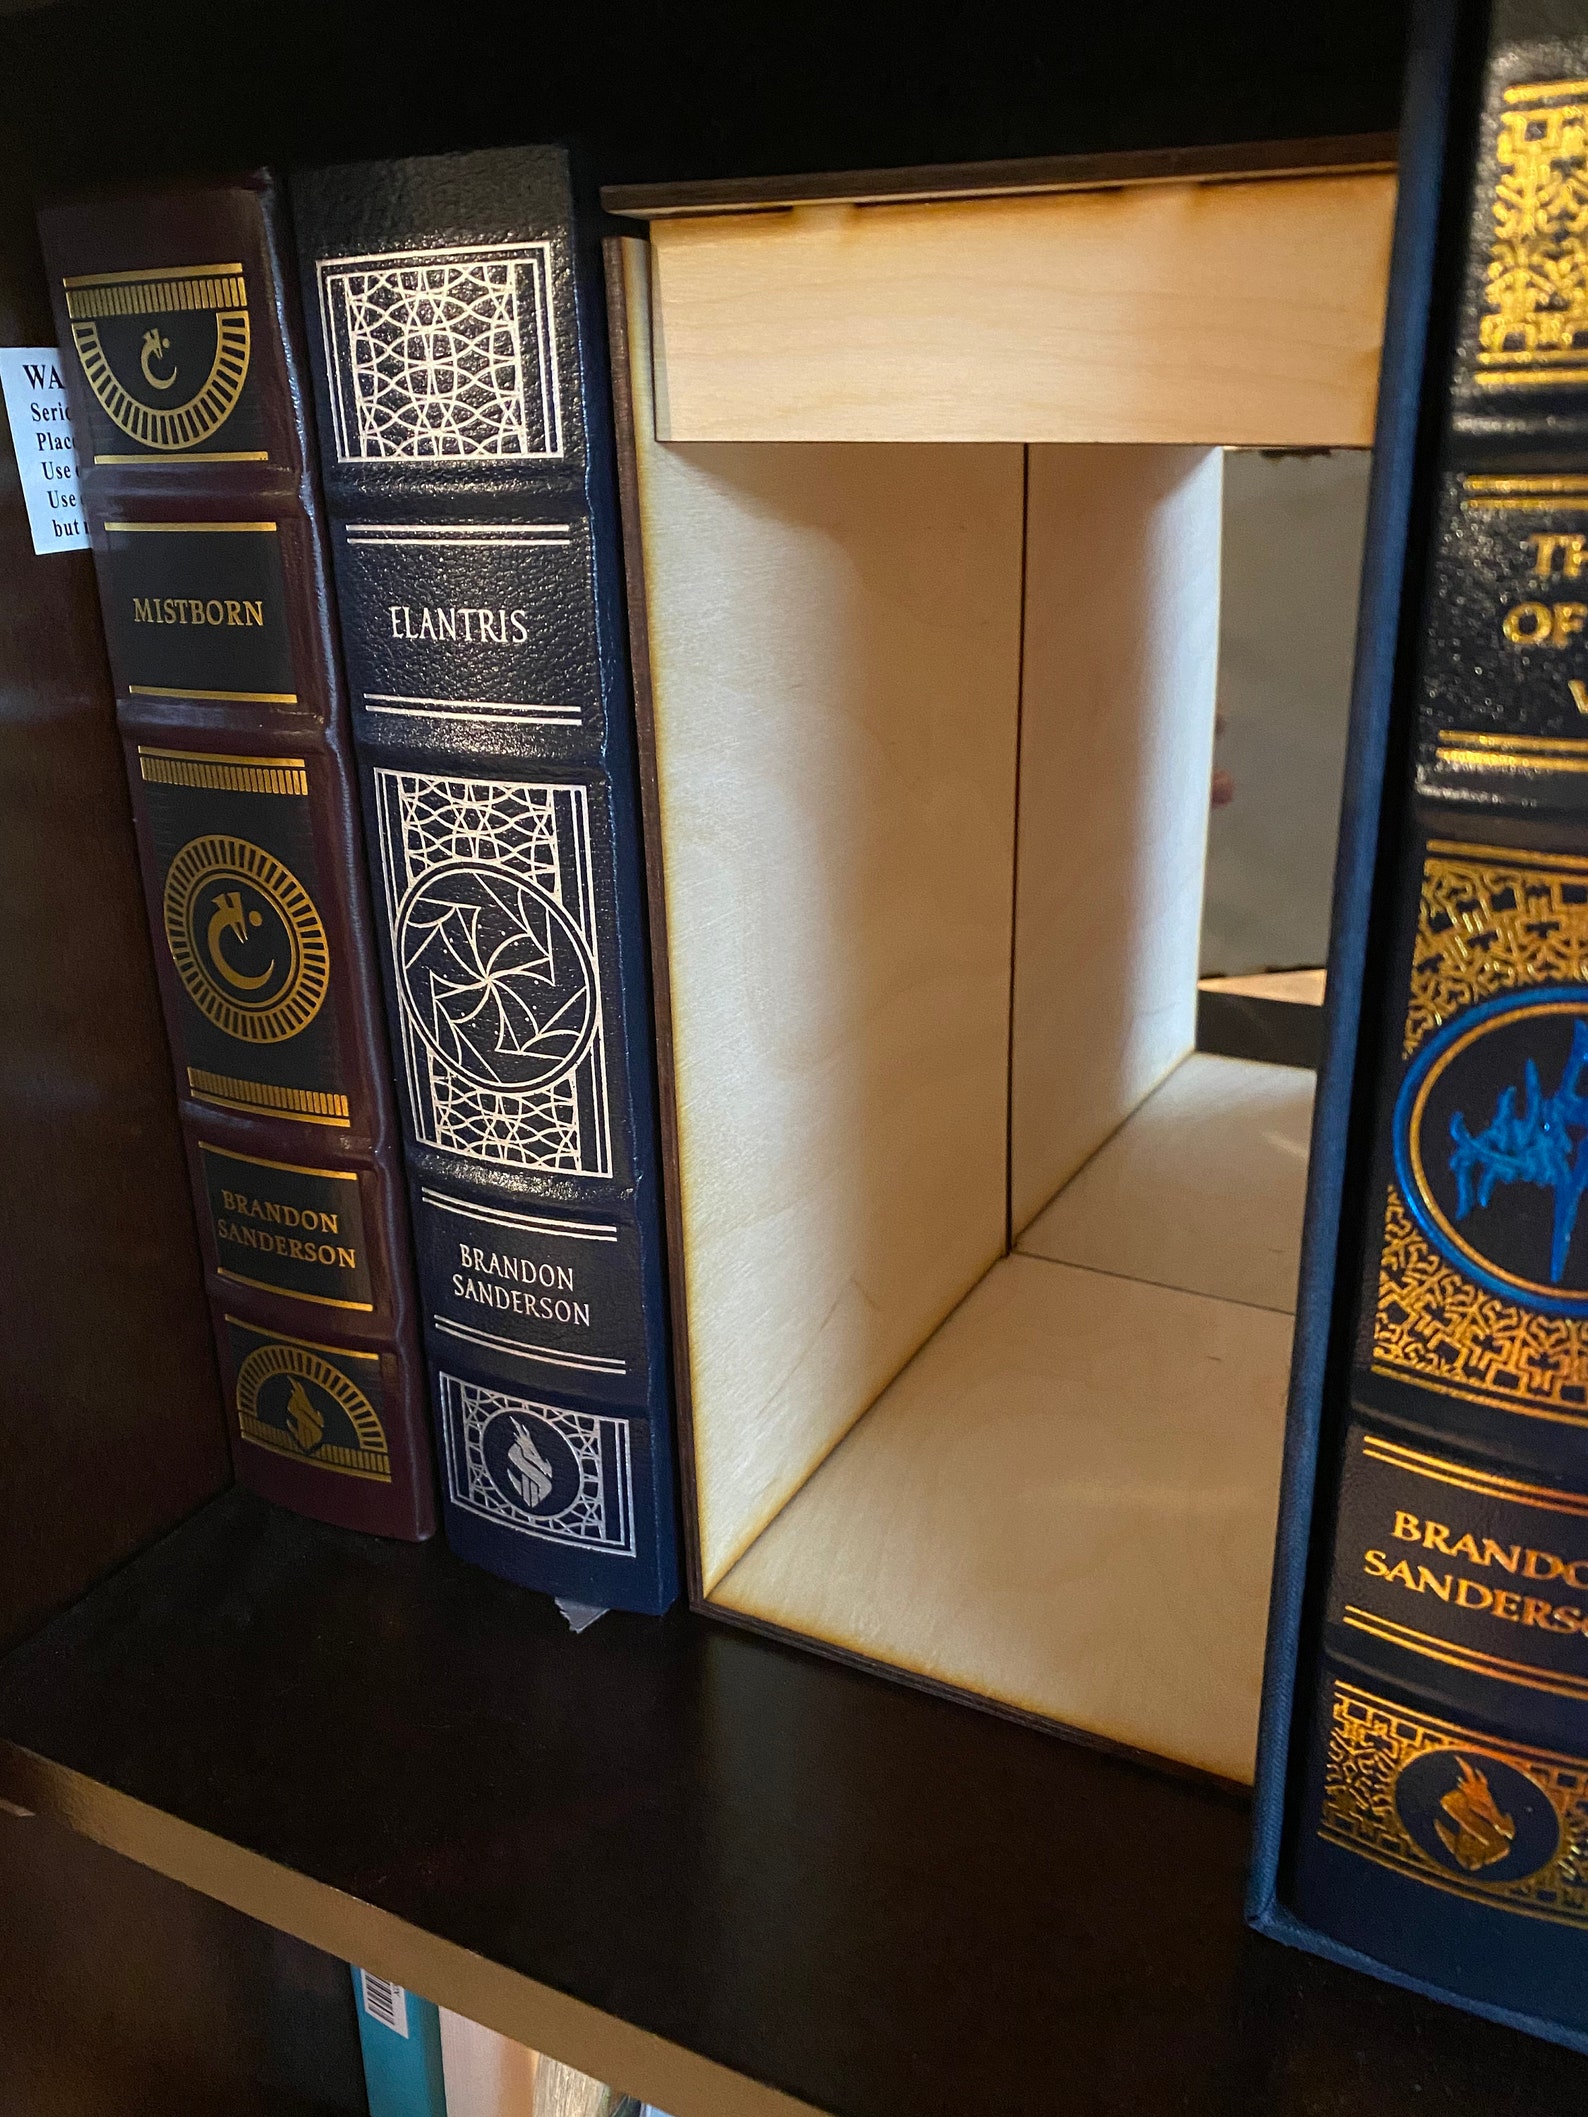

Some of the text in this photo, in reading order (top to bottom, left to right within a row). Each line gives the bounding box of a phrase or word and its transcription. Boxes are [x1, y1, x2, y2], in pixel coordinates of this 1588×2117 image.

[41, 461, 72, 480] Use
[47, 490, 77, 509] Use
[52, 519, 80, 537] but
[133, 597, 264, 627] MISTBORN
[389, 605, 529, 644] ELANTRIS
[1503, 602, 1588, 650] OF
[221, 1189, 339, 1235] BRANDON
[217, 1219, 357, 1269] SANDERSON
[459, 1243, 575, 1292] BRANDON
[451, 1274, 592, 1328] SANDERSON
[1363, 1549, 1588, 1638] SANDERS
